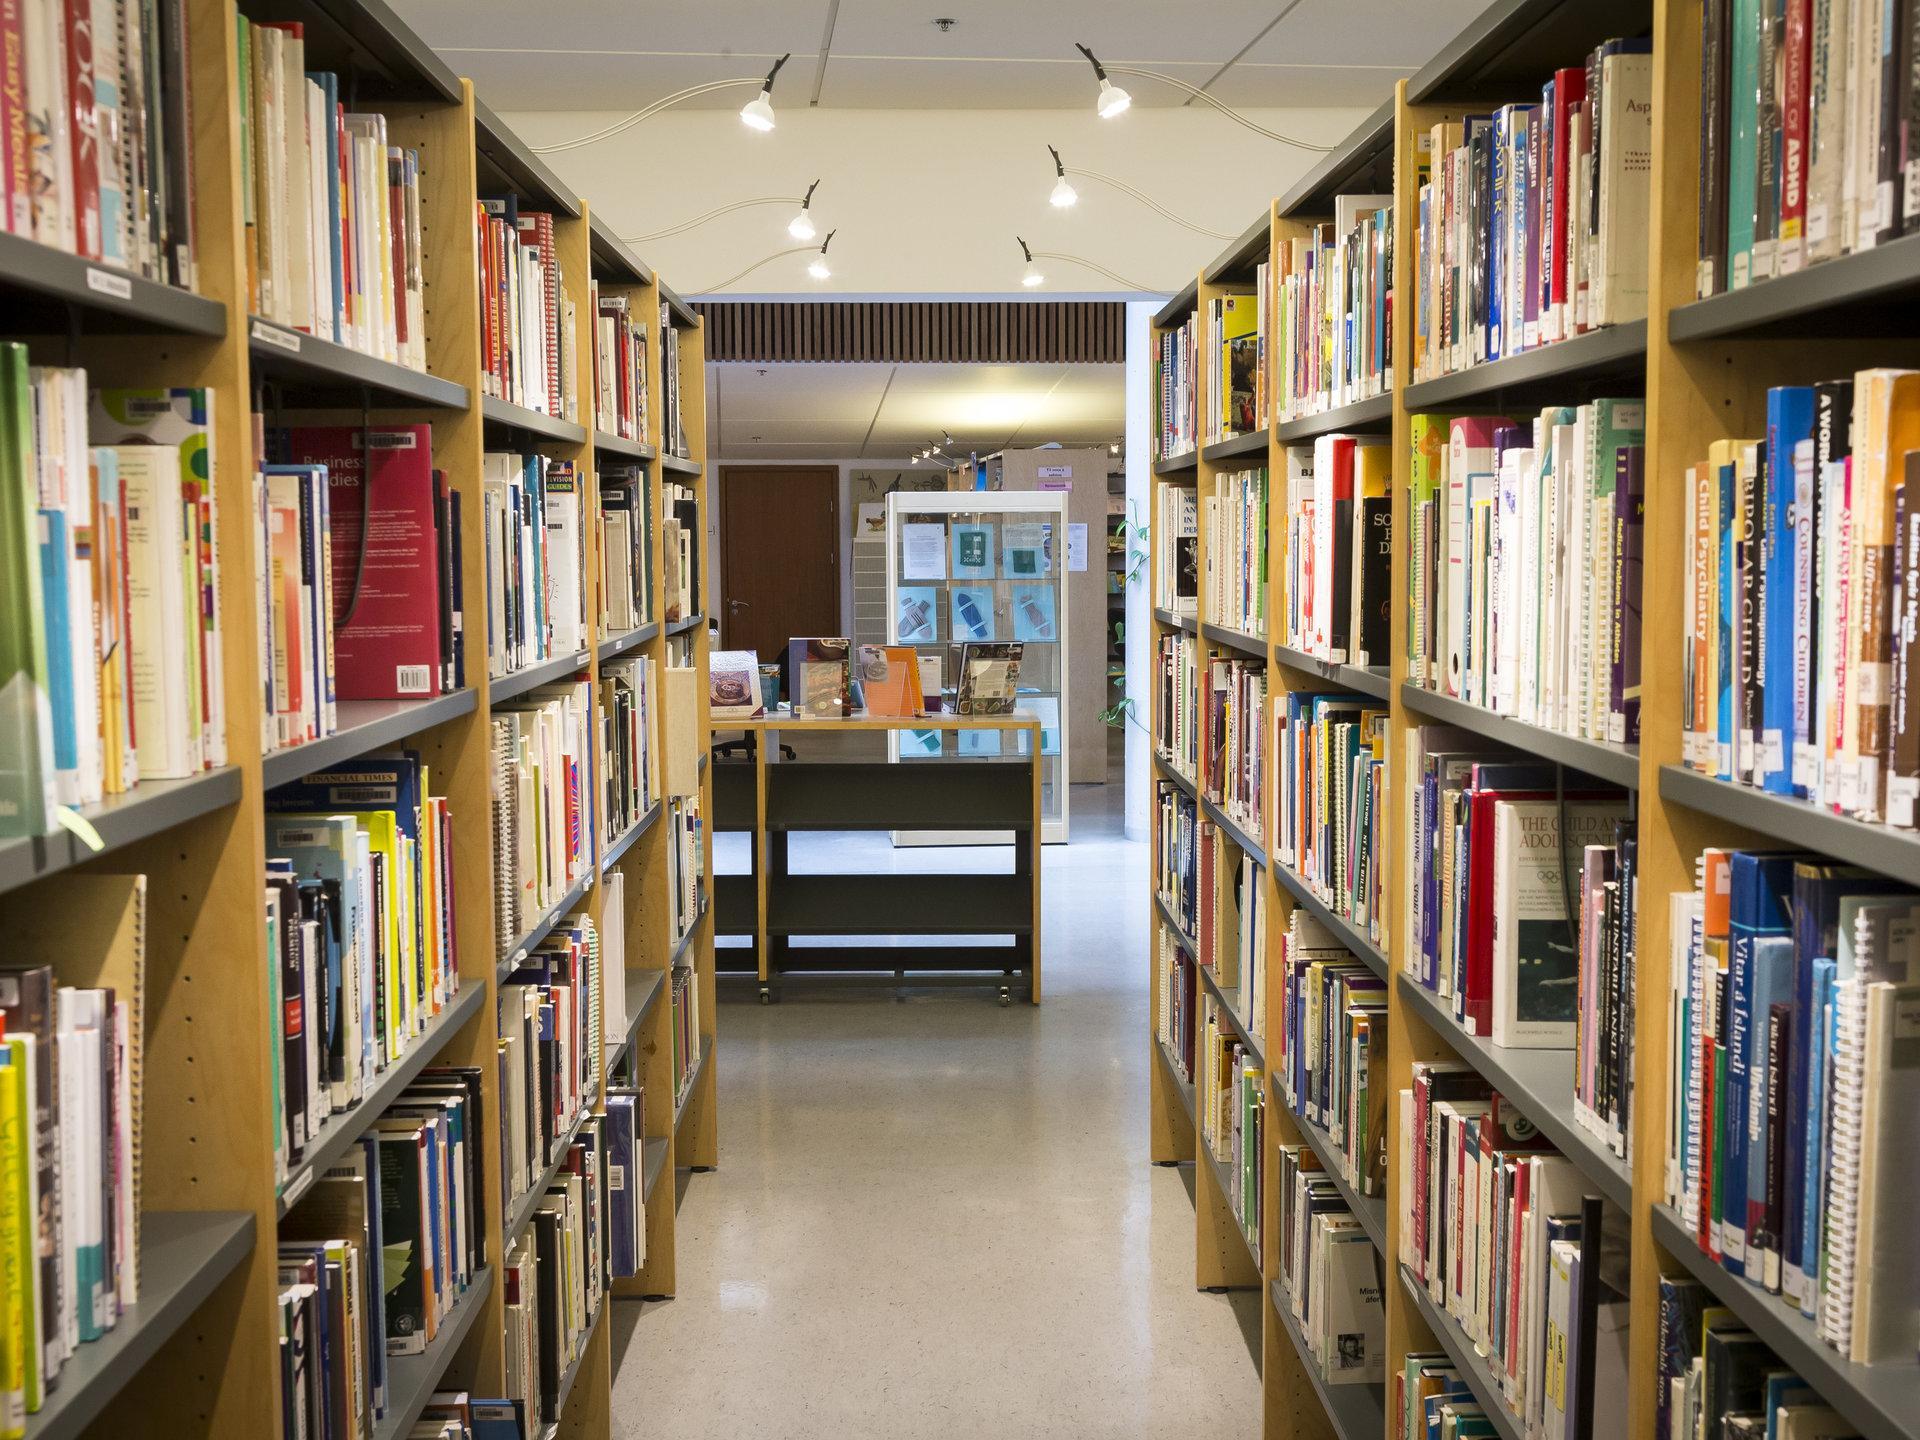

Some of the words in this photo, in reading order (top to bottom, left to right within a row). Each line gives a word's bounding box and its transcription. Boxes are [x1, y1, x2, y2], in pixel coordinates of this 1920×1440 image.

[1493, 118, 1505, 215] DSM-III-R
[1787, 138, 1801, 208] ADHD
[329, 473, 360, 487] dies
[1301, 468, 1315, 478] BJ
[1183, 496, 1197, 504] ME
[1183, 505, 1197, 514] AN
[1373, 513, 1392, 527] SO
[1699, 479, 1710, 531] Child
[1616, 517, 1624, 557] Medical
[1743, 477, 1755, 590] BIPOLAR
[1615, 559, 1623, 606] Problems
[1695, 537, 1709, 641] Psychiatry
[1798, 516, 1812, 627] COUNSELING
[1615, 609, 1622, 619] in
[1742, 598, 1753, 684] CHILD
[1796, 634, 1811, 722] CHILDREN
[307, 774, 360, 784] FINANCIAL
[363, 773, 394, 782] TIMES
[1519, 833, 1614, 849] ADOLSCENT
[1520, 816, 1548, 831] THE
[287, 918, 296, 969] PREMIUM
[1612, 918, 1620, 1000] UNSTABLE
[1736, 936, 1749, 987] Vitar
[1735, 990, 1746, 1002] á
[1610, 1004, 1618, 1060] ANKLE
[1733, 1006, 1749, 1076] Íslandi
[1359, 1288, 1378, 1296] Misn
[1656, 1299, 1670, 1374] Gyldendals
[1655, 1375, 1666, 1409] store
